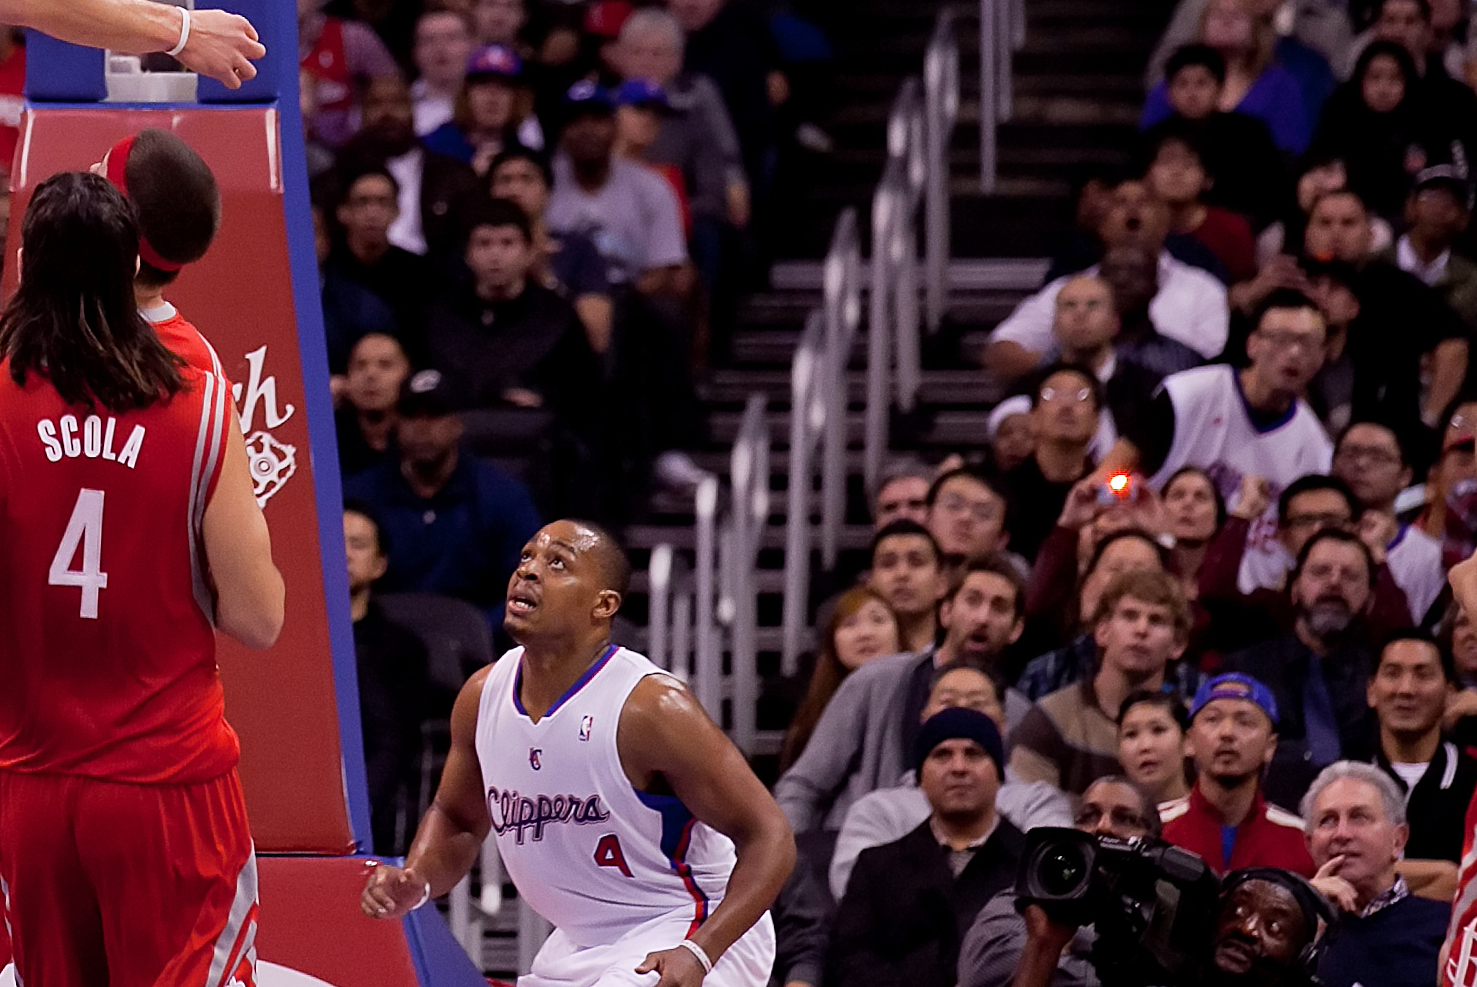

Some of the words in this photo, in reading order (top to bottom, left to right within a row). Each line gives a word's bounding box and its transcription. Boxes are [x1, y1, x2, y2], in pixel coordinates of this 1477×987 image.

[36, 414, 147, 470] SCOLA
[47, 487, 109, 620] 4
[487, 785, 612, 846] Clippers
[593, 833, 636, 879] 4
